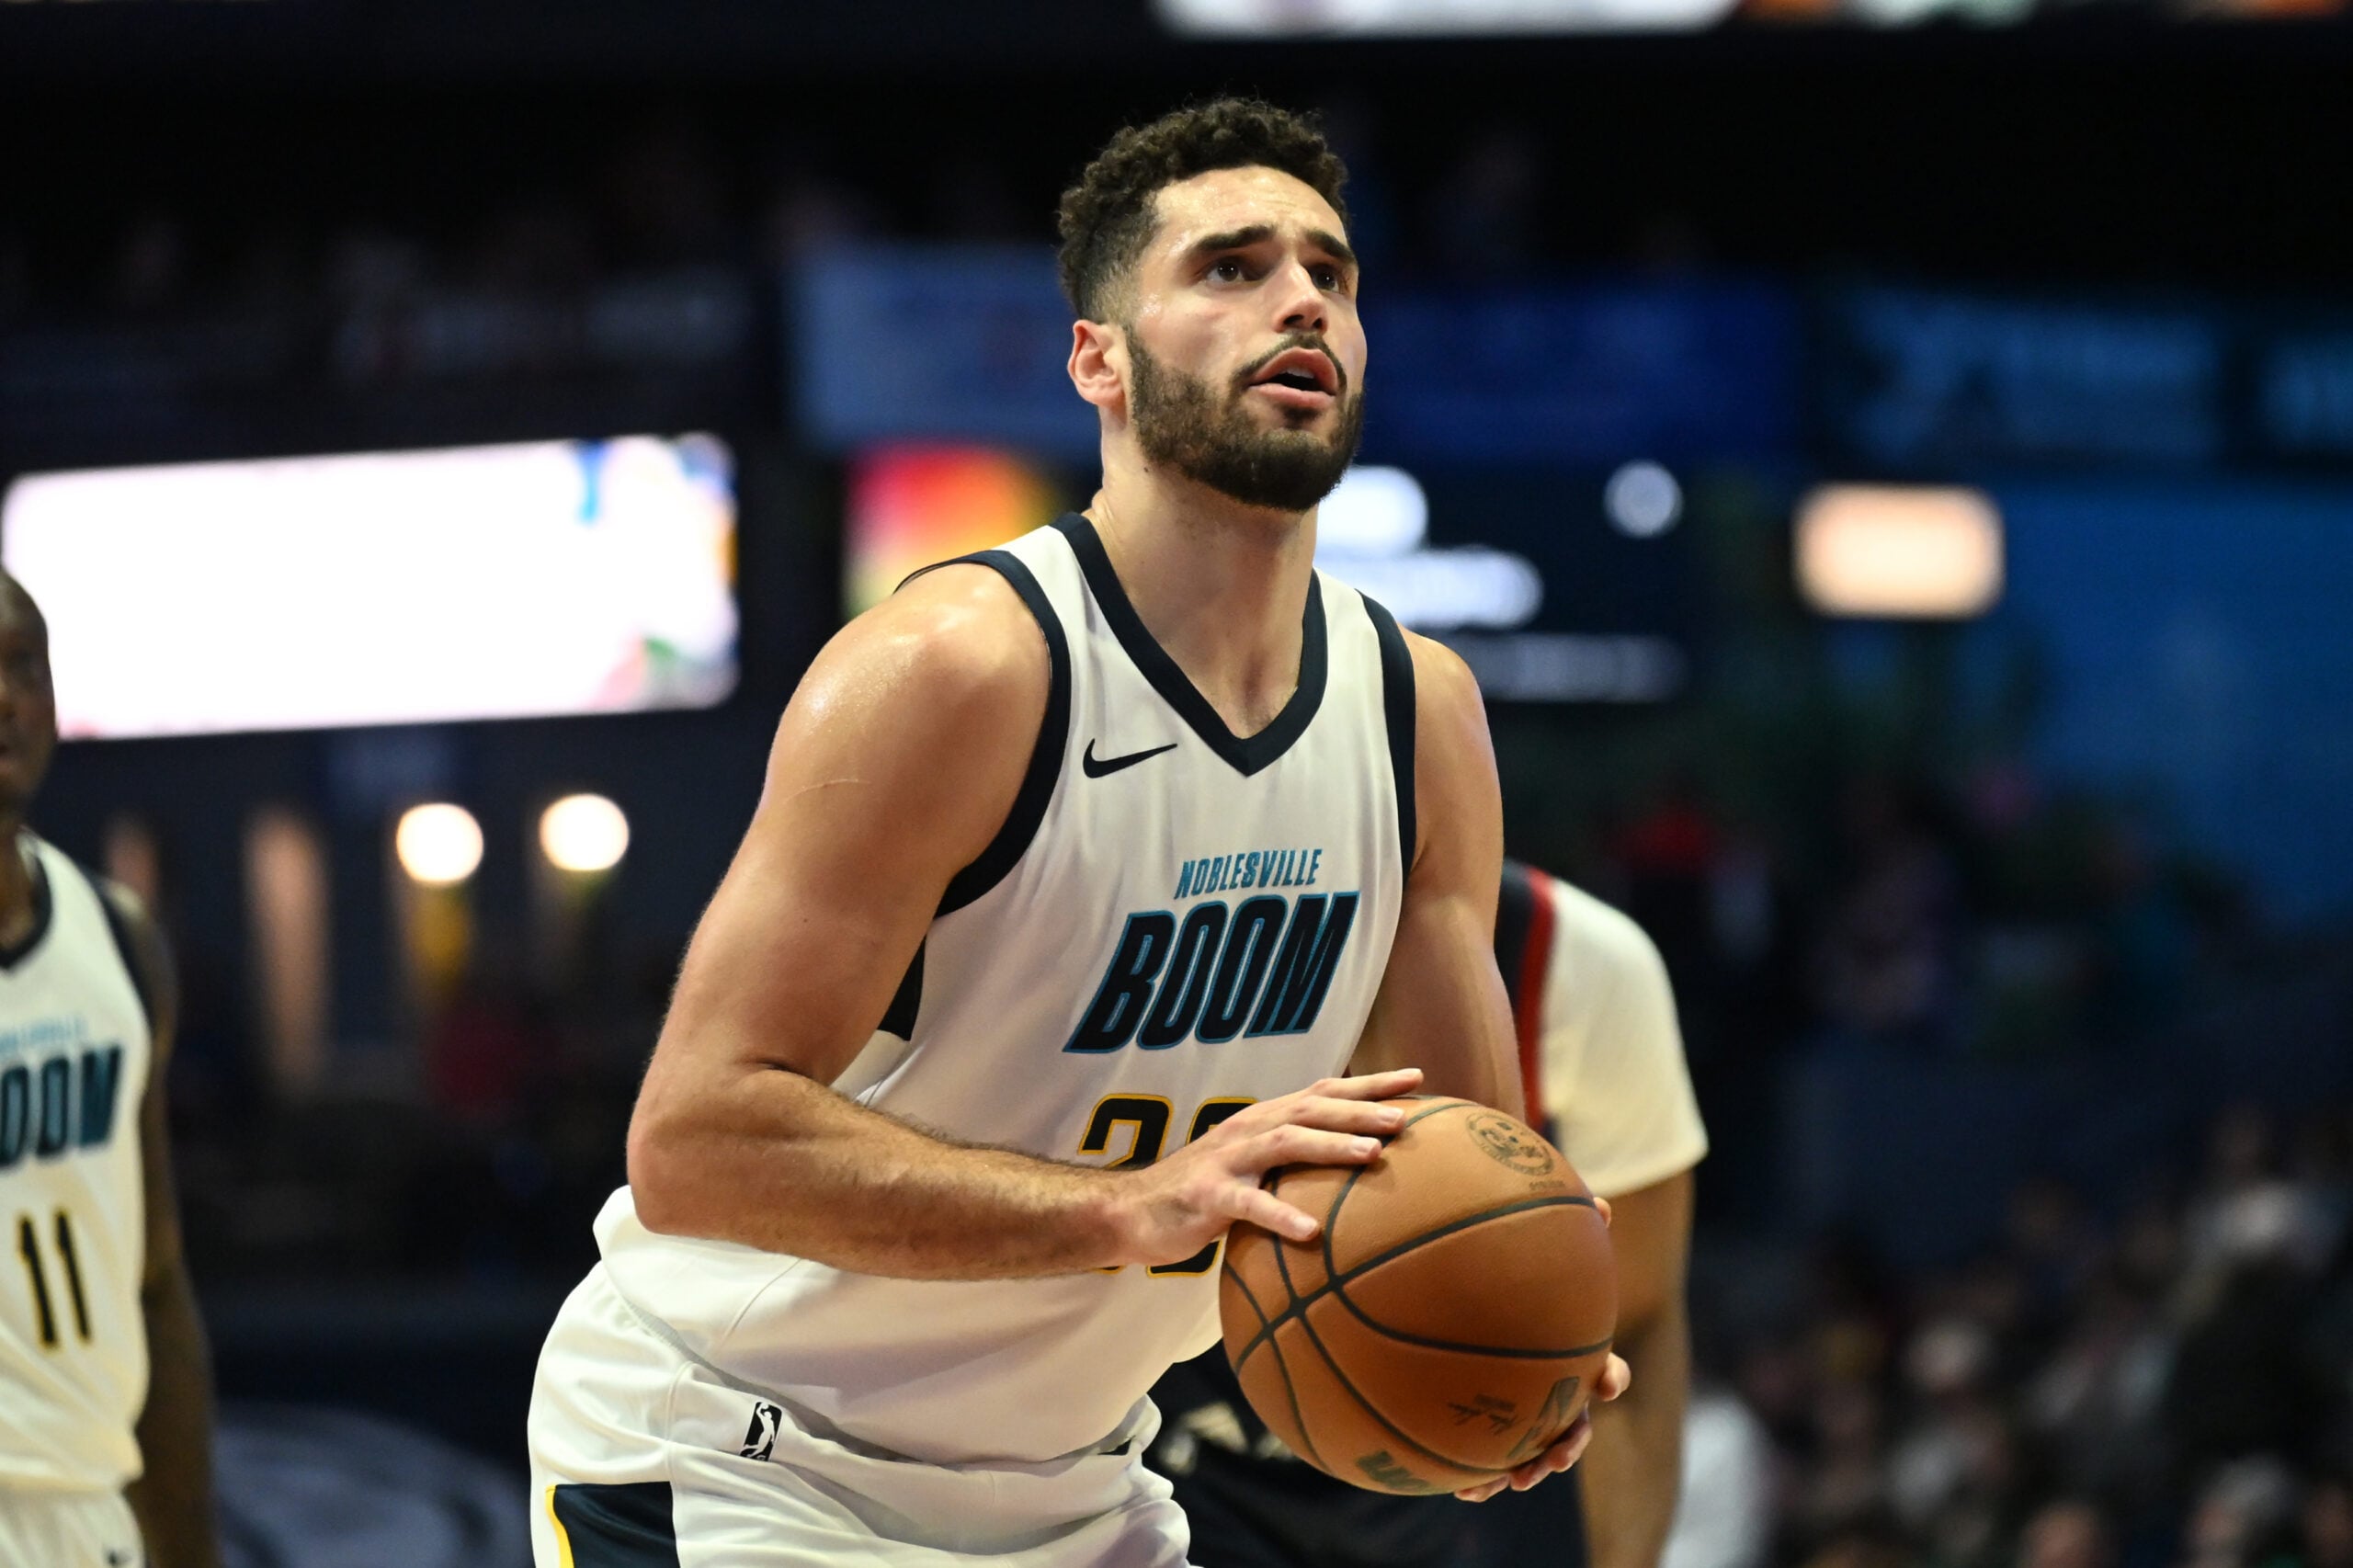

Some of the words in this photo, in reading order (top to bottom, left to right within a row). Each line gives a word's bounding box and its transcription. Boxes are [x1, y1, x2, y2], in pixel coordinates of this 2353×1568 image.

[1174, 848, 1323, 900] NOBLESVILLE
[1062, 891, 1360, 1053] BOOM
[0, 1044, 124, 1169] OOM
[17, 1208, 94, 1351] 11
